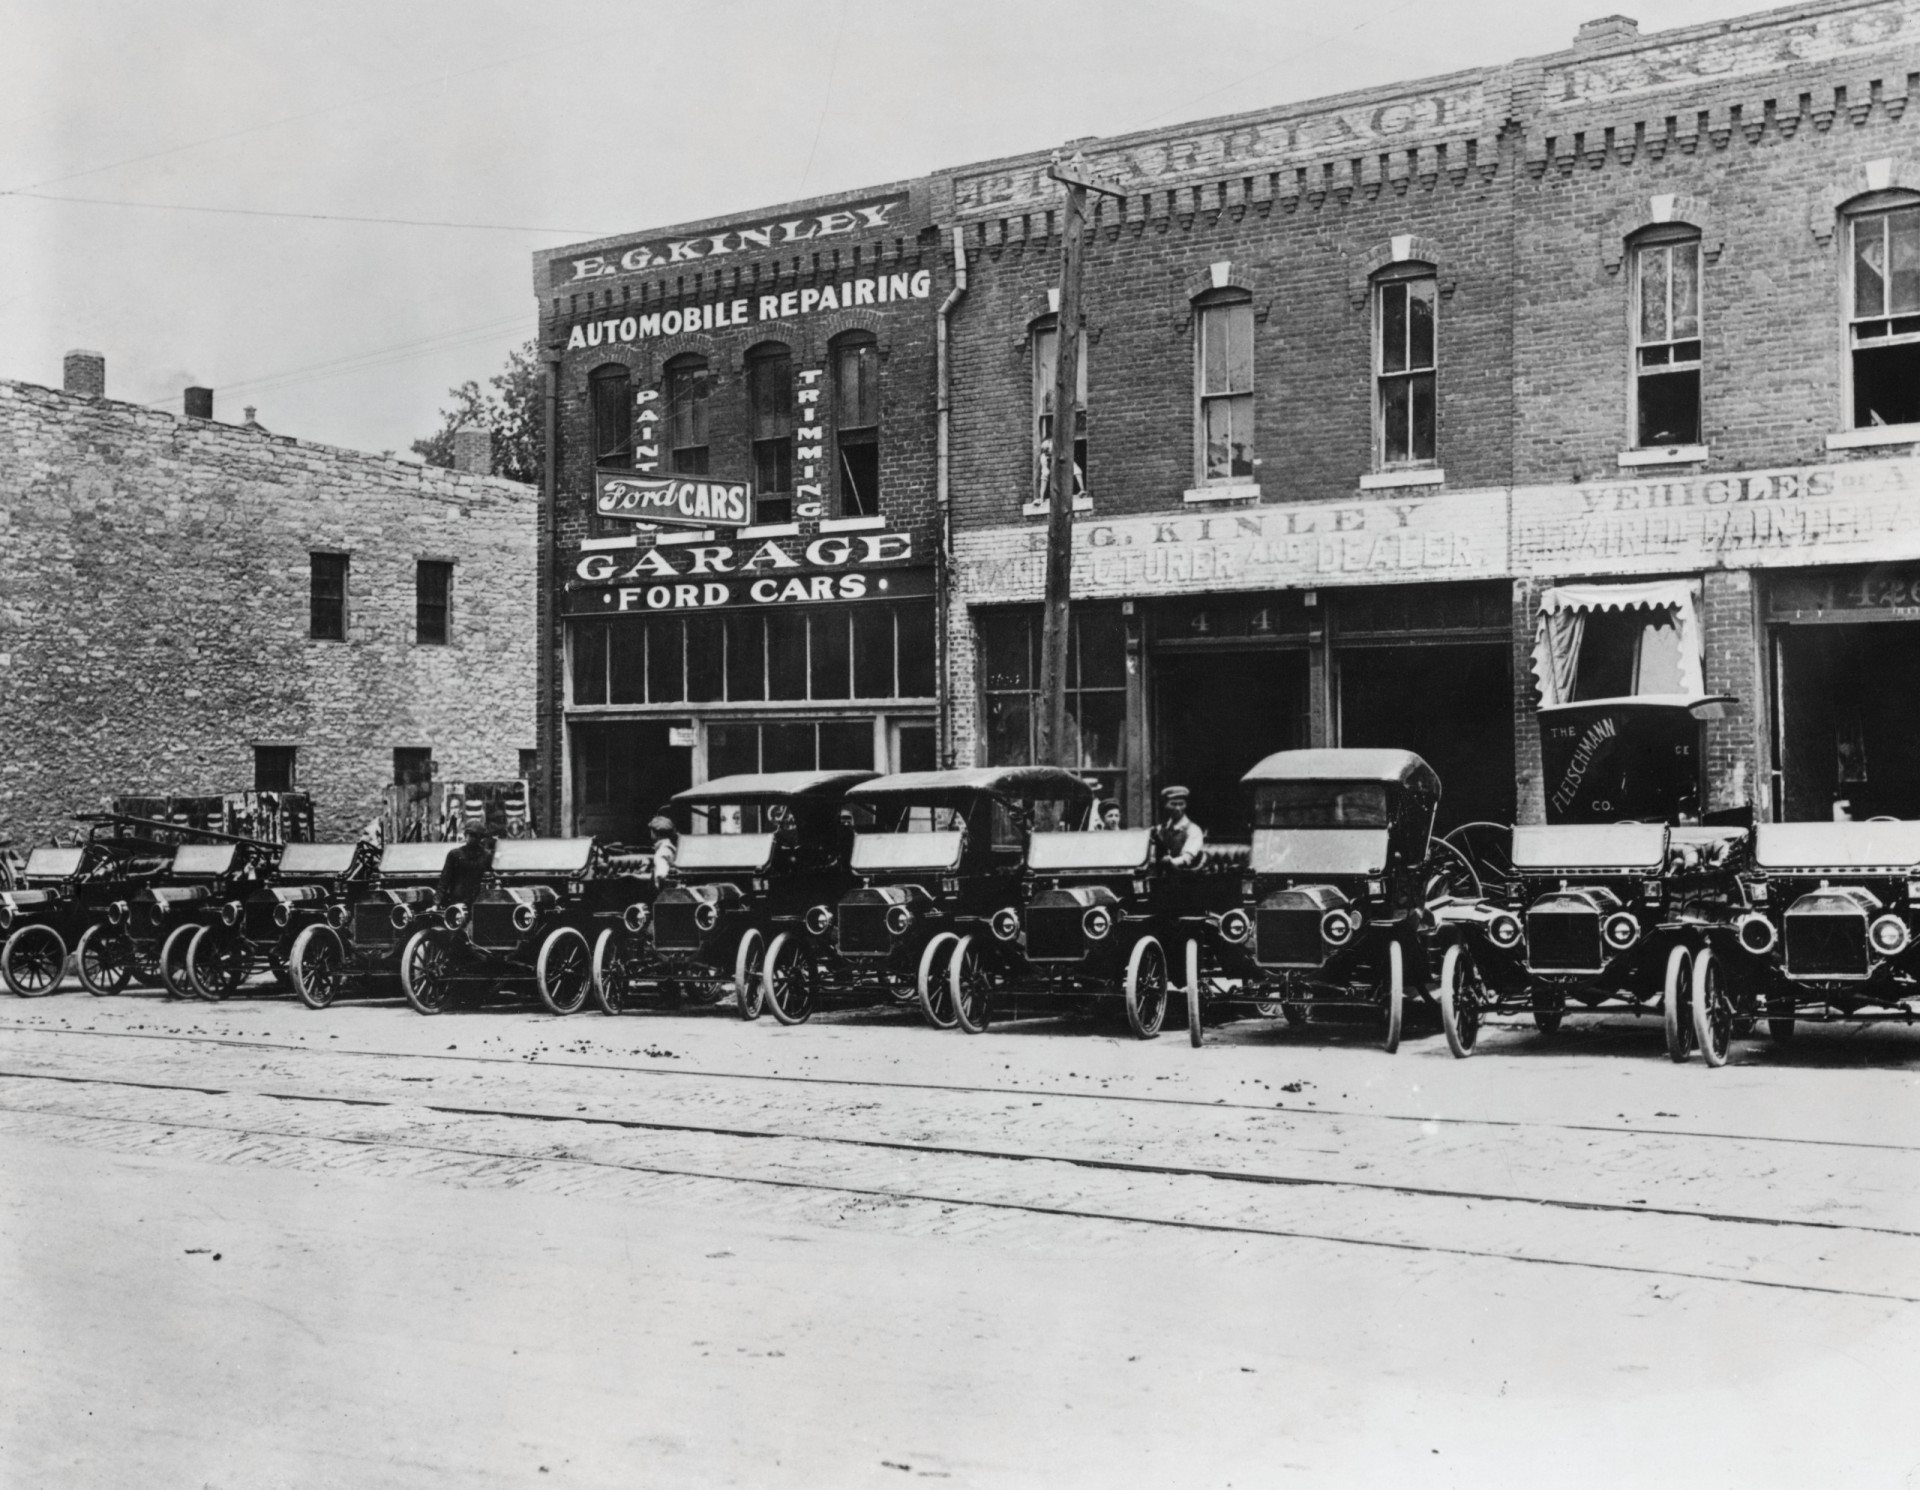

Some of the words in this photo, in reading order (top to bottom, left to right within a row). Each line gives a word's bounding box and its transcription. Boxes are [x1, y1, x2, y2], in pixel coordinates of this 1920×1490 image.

[567, 298, 749, 350] AUTOMOBILE
[759, 269, 932, 321] REPAIRING
[797, 369, 822, 517] TRIMMING
[599, 478, 678, 511] Ford
[678, 483, 745, 520] CARS
[1575, 470, 1835, 511] VEHICLES
[1087, 526, 1133, 548] G.
[1151, 503, 1425, 544] KINLEY
[576, 533, 912, 581] GARAGE
[618, 583, 730, 611] FORD
[750, 574, 866, 602] CARS
[1550, 726, 1577, 738] THE
[1551, 718, 1616, 814] FLEISCHMANN
[1592, 800, 1615, 811] CO.
